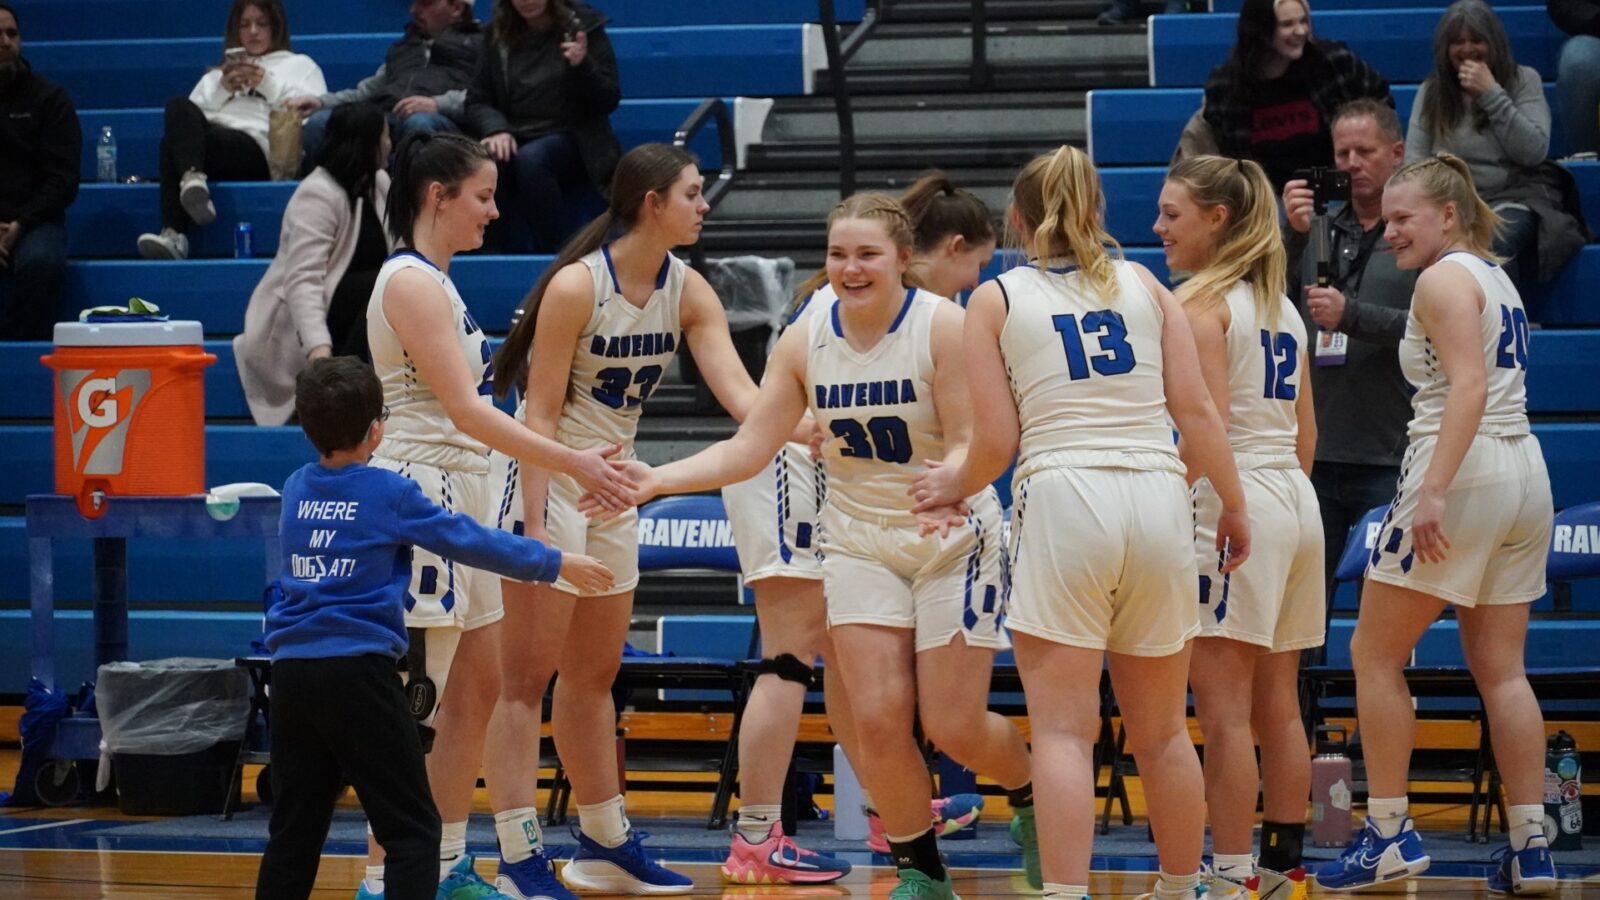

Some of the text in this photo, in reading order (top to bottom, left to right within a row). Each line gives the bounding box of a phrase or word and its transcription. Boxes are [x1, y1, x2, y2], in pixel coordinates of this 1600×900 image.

[590, 332, 675, 358] RAVENNA
[1052, 309, 1136, 381] 13
[1496, 303, 1529, 372] 20
[1260, 328, 1298, 401] 12
[591, 365, 662, 409] 33
[815, 379, 918, 409] RAVENNA
[77, 377, 118, 428] G
[829, 416, 913, 464] 30
[297, 500, 359, 520] WHERE
[309, 529, 337, 548] MY
[795, 522, 813, 549] R
[327, 558, 357, 577] AT!
[419, 565, 439, 595] R
